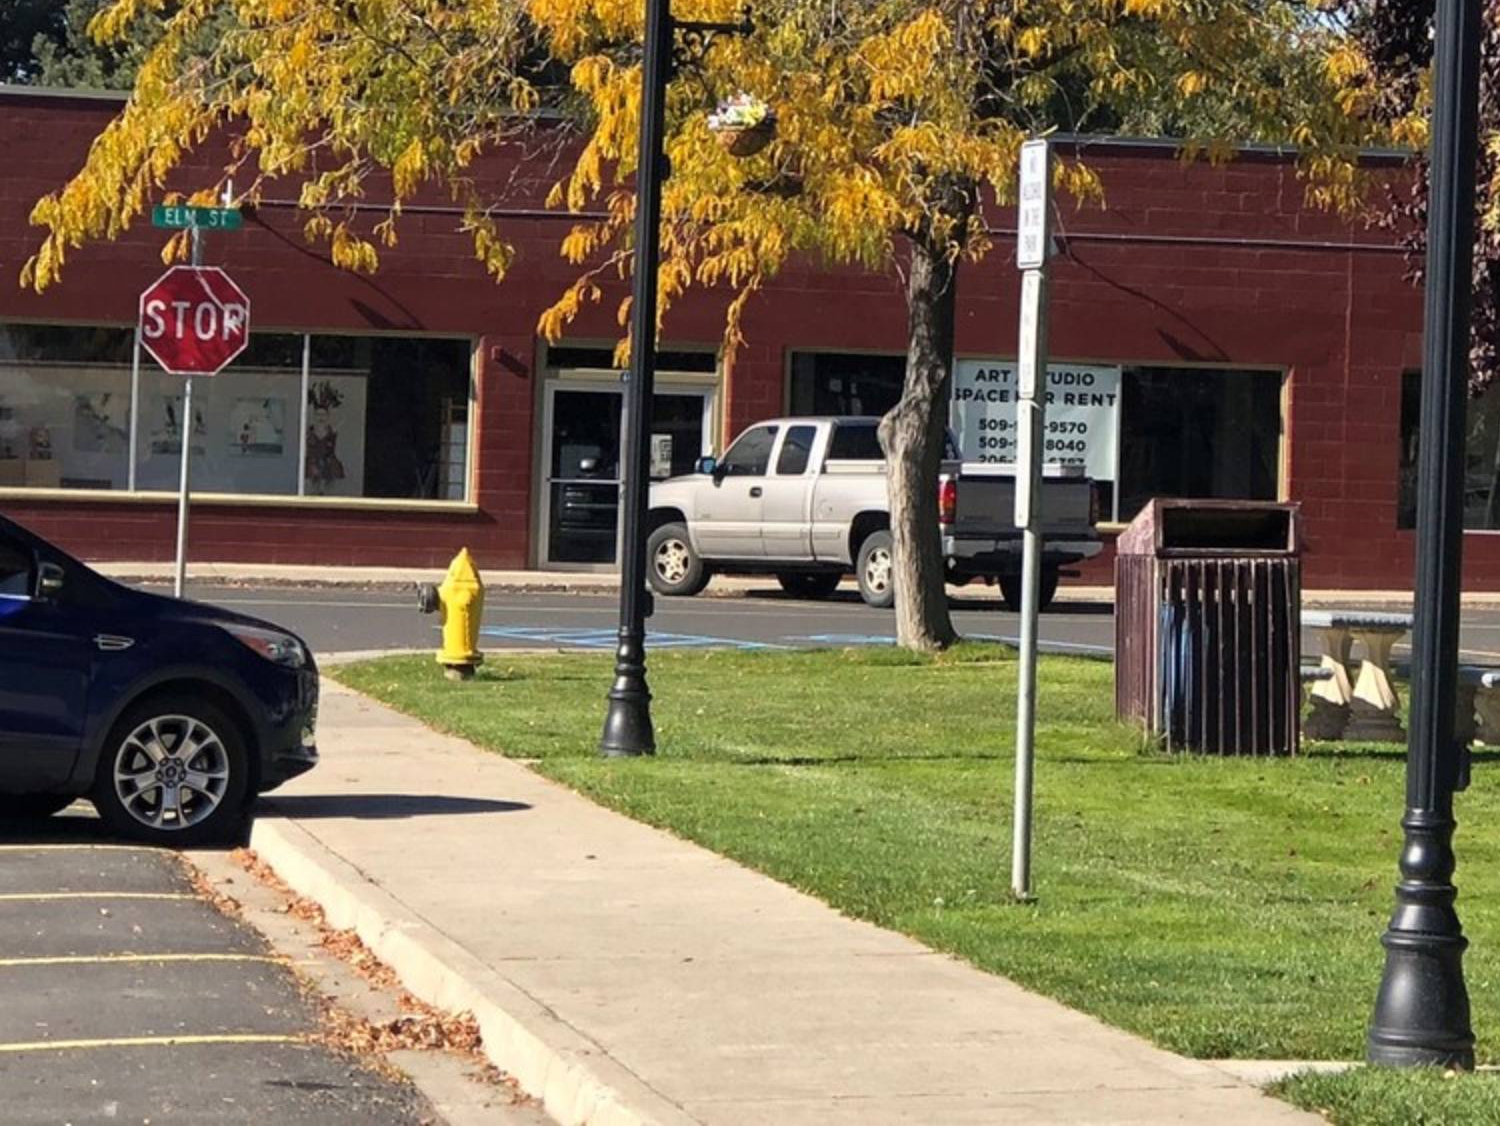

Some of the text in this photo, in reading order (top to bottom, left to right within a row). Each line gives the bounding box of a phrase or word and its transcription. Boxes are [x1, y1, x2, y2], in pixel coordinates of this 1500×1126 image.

[164, 207, 229, 227] ELM ST
[143, 300, 246, 342] STOP
[974, 368, 1011, 384] ART
[954, 387, 1009, 403] SPACE
[1063, 392, 1117, 407] RENT
[978, 417, 1088, 434] 509--9570
